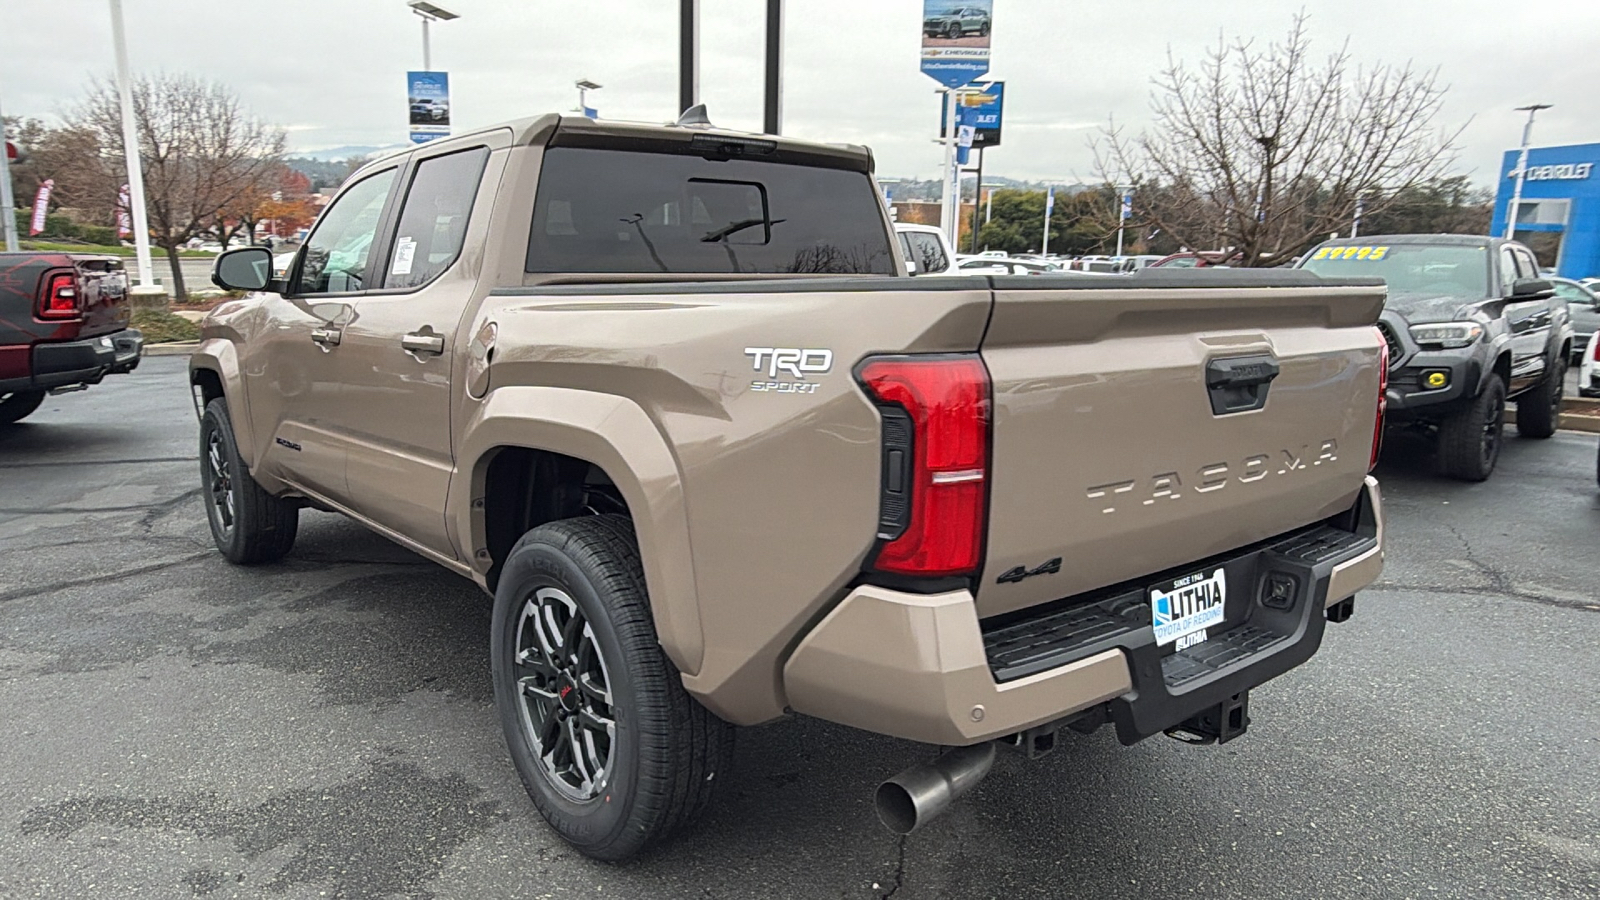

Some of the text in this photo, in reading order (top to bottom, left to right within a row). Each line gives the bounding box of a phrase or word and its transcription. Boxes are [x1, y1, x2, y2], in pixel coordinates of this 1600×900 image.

[1526, 163, 1594, 181] CHEVROLET
[744, 347, 833, 378] TRD
[750, 381, 820, 394] SPORT
[1087, 438, 1337, 513] TACOMA
[1173, 577, 1190, 588] SINCE
[1170, 581, 1221, 621] LITHIA
[1154, 607, 1221, 638] TOYOTA OF REDDING
[1182, 629, 1207, 648] LITHIA
